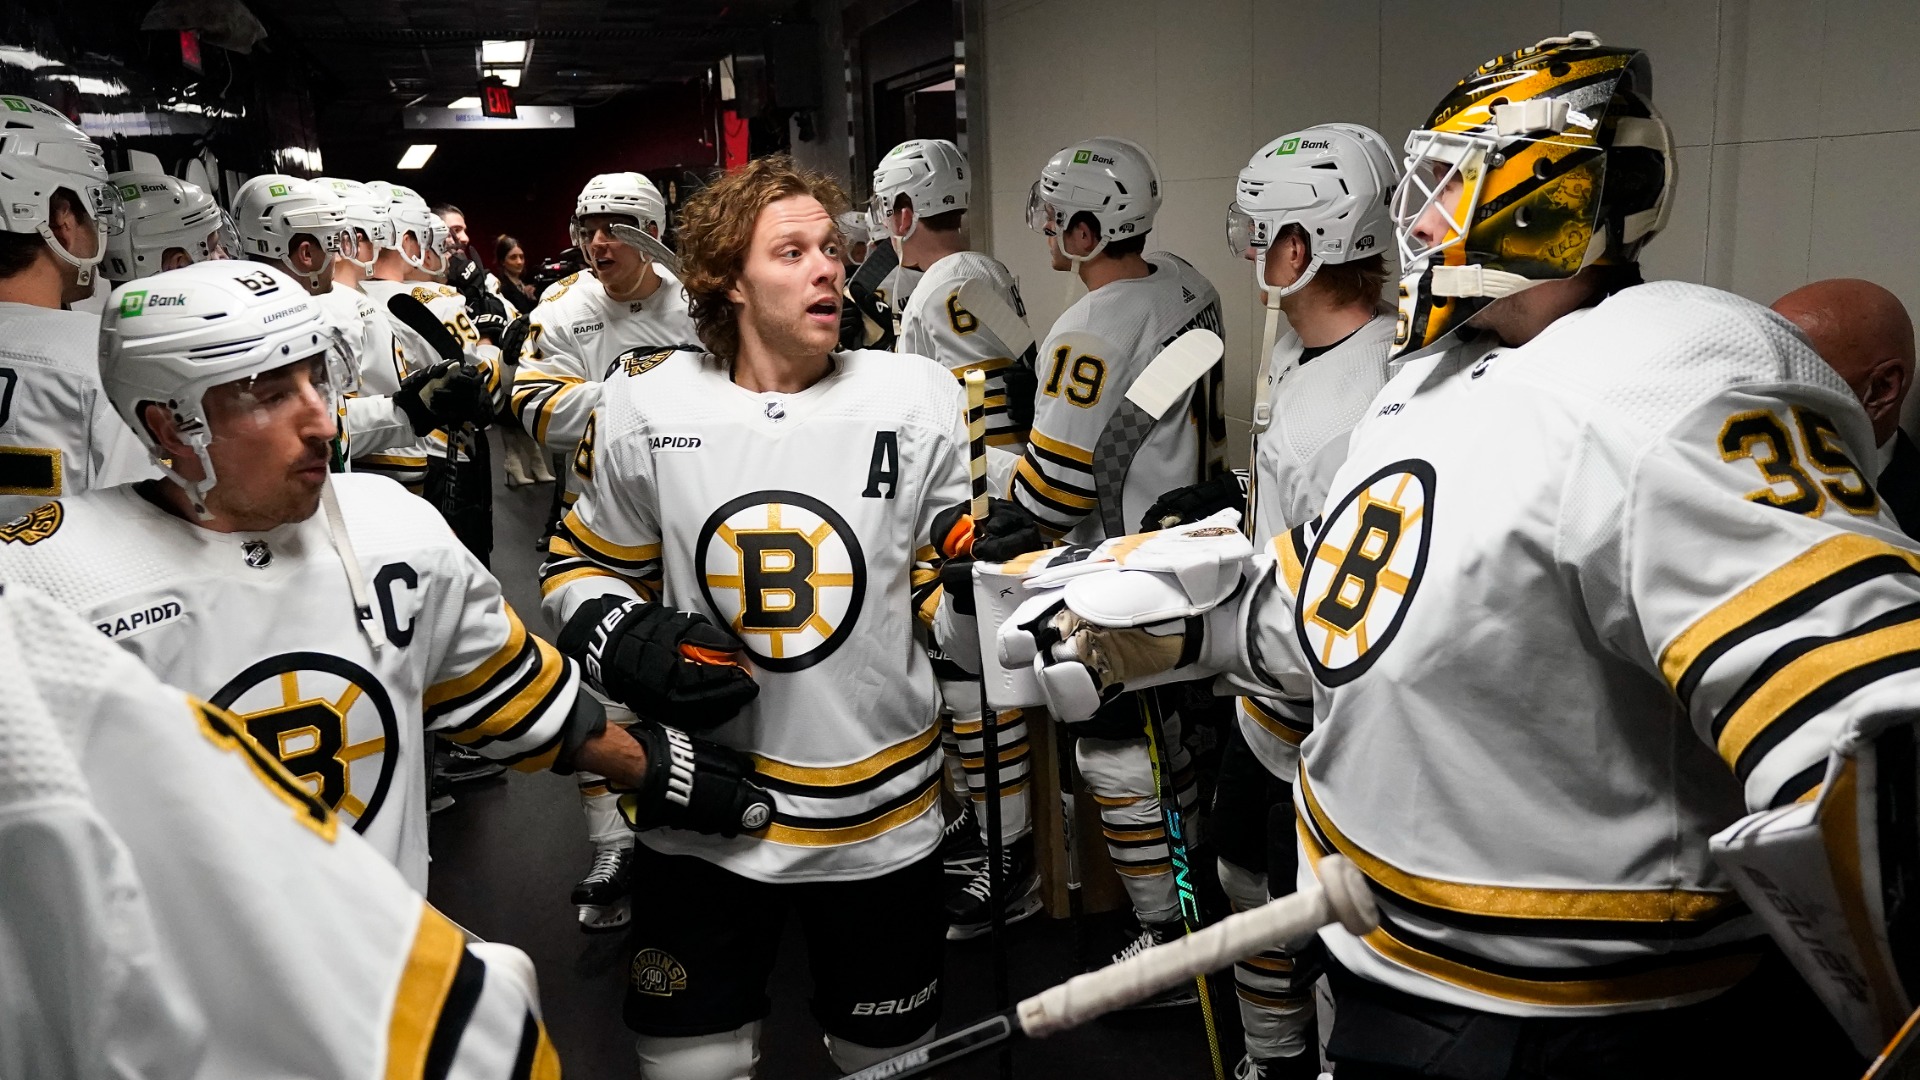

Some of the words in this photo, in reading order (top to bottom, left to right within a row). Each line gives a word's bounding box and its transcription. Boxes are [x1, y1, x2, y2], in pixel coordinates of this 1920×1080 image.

[486, 86, 511, 114] EXIT
[1076, 151, 1090, 163] TD
[1091, 154, 1115, 166] Bank
[1278, 139, 1299, 154] TD
[1300, 140, 1331, 150] Bank
[956, 167, 964, 180] 6
[121, 185, 139, 200] TD
[140, 183, 169, 193] Bank
[271, 186, 285, 196] TD
[584, 193, 608, 202] CCM
[233, 270, 276, 292] 63
[121, 293, 145, 317] TD
[148, 292, 187, 308] Bank
[263, 303, 309, 325] WARRIOR
[945, 291, 980, 337] 6
[1043, 344, 1108, 410] 19
[862, 431, 899, 499] A
[1716, 404, 1881, 519] 35
[734, 529, 819, 633] B
[1313, 499, 1406, 640] B
[373, 562, 418, 649] C
[239, 697, 349, 814] B
[1166, 808, 1200, 923] SYNC
[851, 977, 938, 1016] BAUER
